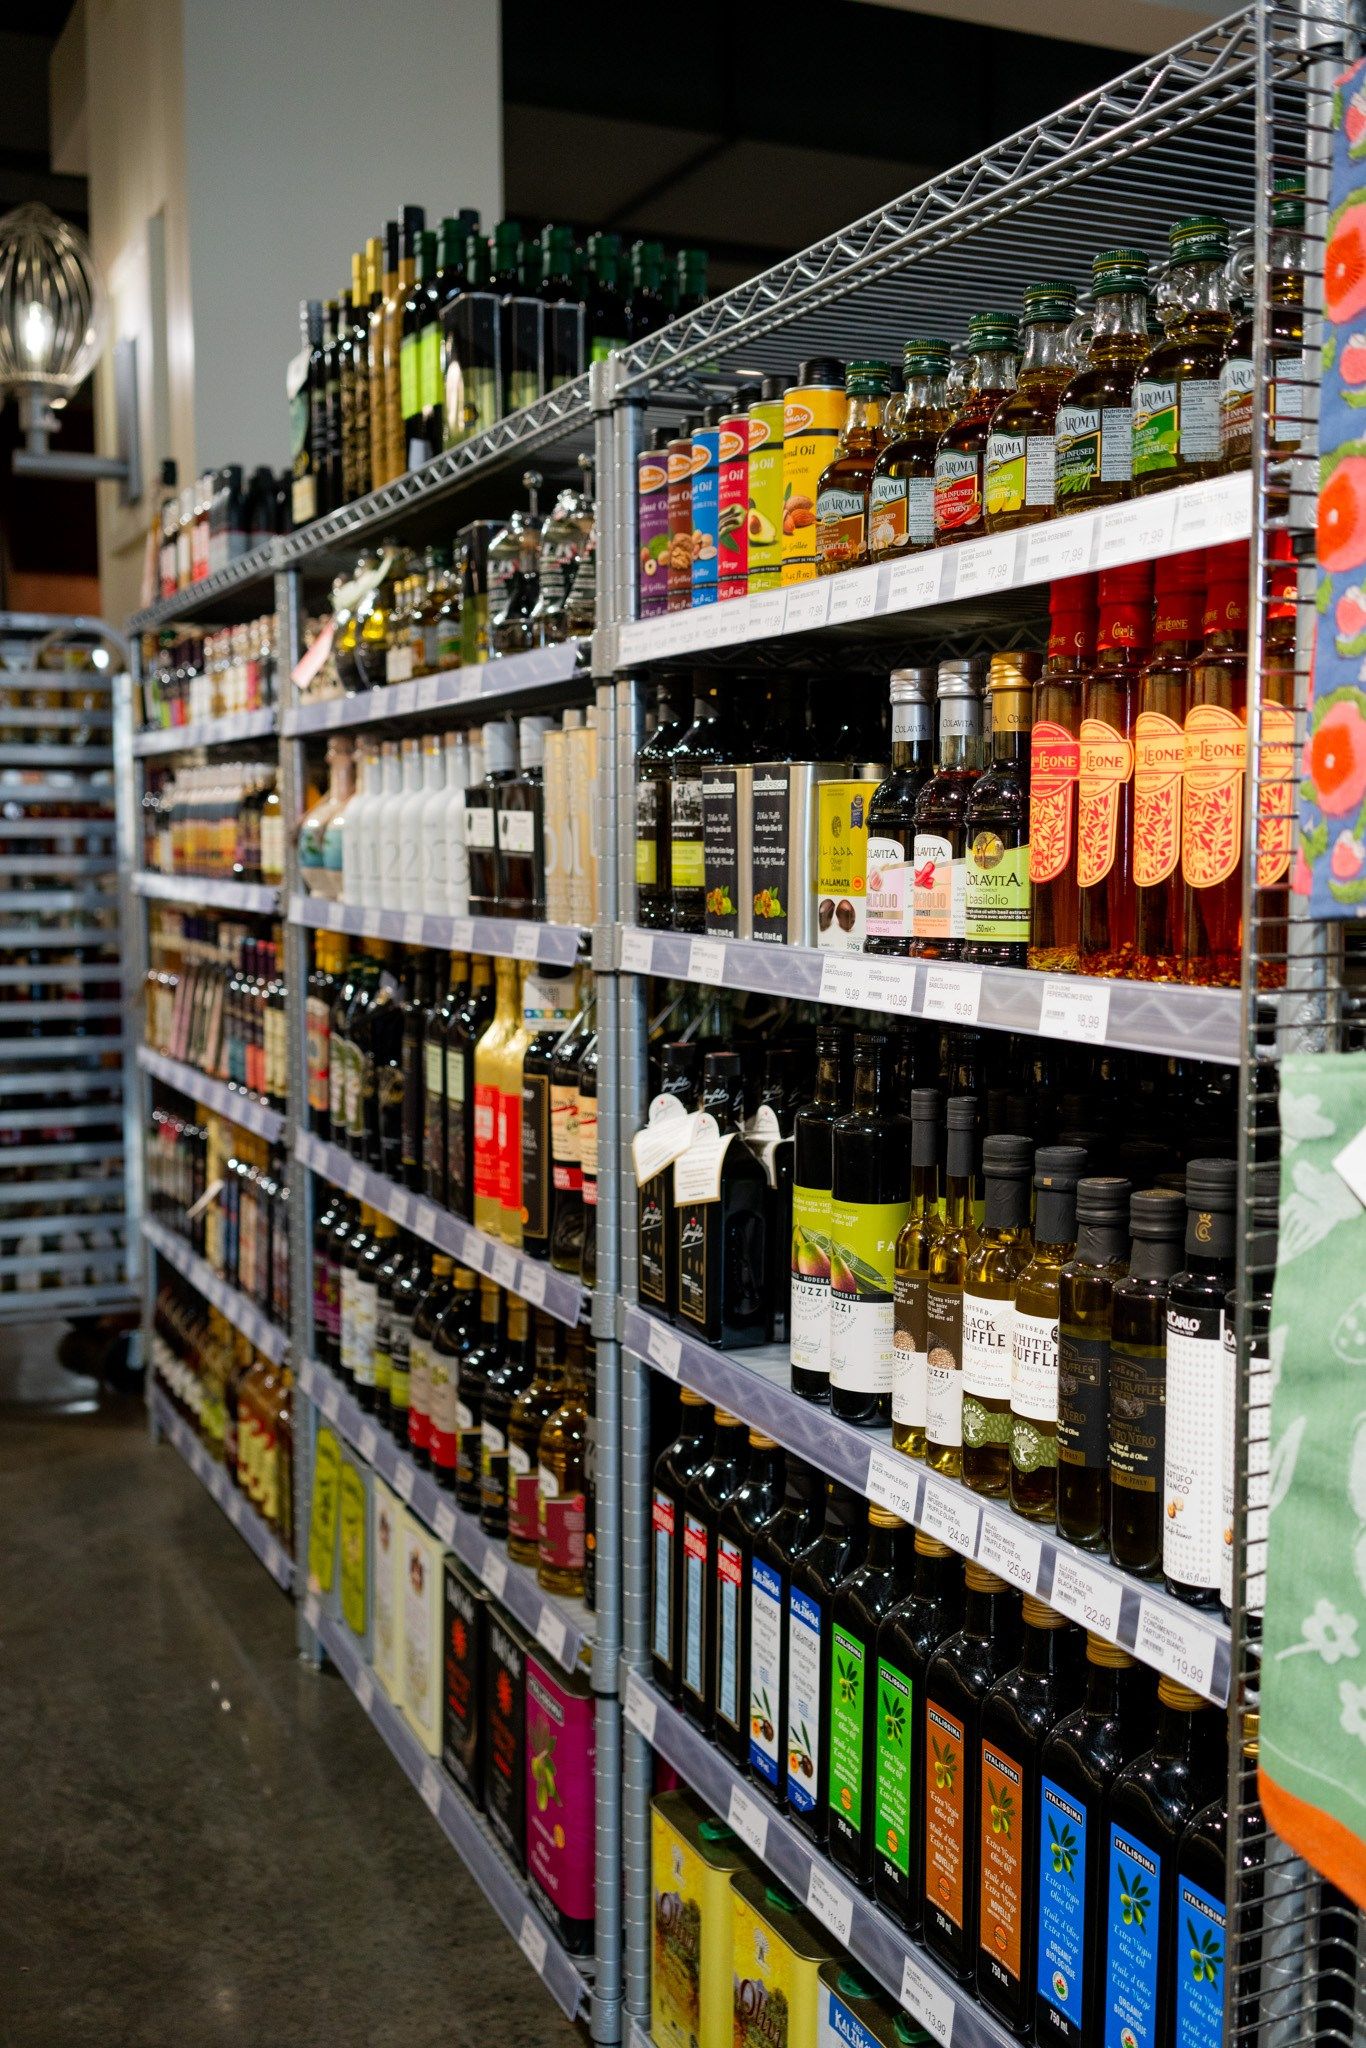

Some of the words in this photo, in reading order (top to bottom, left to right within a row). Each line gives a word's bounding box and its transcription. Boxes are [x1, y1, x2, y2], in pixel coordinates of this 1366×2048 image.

[1039, 751, 1078, 772] LEONE
[1086, 750, 1124, 772] LEONE
[1144, 745, 1184, 767] LEONE
[1200, 738, 1246, 762] LEONE
[926, 1503, 943, 1518] TRUFFLE
[927, 1495, 943, 1509] INFUSED
[942, 1504, 956, 1516] BLACK
[946, 1525, 970, 1548] $24.99
[984, 1527, 1002, 1542] INFUSED
[1002, 1536, 1016, 1549] WHITE
[984, 1534, 1002, 1551] TRUFFLE
[1001, 1544, 1013, 1555] OLIVE
[1013, 1553, 1022, 1562] OIL
[1007, 1560, 1032, 1584] $25.99
[1057, 1577, 1072, 1590] BLACK
[1058, 1570, 1078, 1585] TRUFFLE
[1083, 1604, 1111, 1631] $22.99
[1143, 1616, 1177, 1640] CONDIMENTO
[1178, 1636, 1185, 1645] AL
[1142, 1625, 1166, 1644] TARTUFO
[1166, 1639, 1187, 1655] BIANCO
[1172, 1655, 1204, 1683] $19.99
[930, 1709, 961, 1740] ITALISSIMA
[985, 1751, 1019, 1784] ITALISSIMA
[1045, 1790, 1082, 1824] ITALISSIMA
[1114, 1837, 1155, 1874] ITALISSIMA
[1044, 1871, 1062, 1891] Extra
[1062, 1883, 1080, 1906] Virgin
[1065, 1901, 1075, 1915] Oil
[1043, 1919, 1061, 1938] Extra
[1113, 1923, 1132, 1944] Extra
[1132, 1936, 1152, 1960] Virgin
[1045, 1948, 1076, 1981] BIOLOGIQUE
[1050, 1940, 1073, 1966] ORGANIC
[1119, 1942, 1135, 1960] Olive
[1135, 1955, 1146, 1969] Oil
[991, 1962, 1001, 1979] 750
[1112, 1973, 1130, 1993] Extra
[1131, 1988, 1151, 2011] Vierge
[1183, 1979, 1203, 2000] Extra
[1113, 2003, 1148, 2038] BIOLOGIQUE
[1118, 1995, 1143, 2022] ORGANIC
[1189, 2000, 1206, 2018] Olive
[1207, 2014, 1218, 2028] Oil
[1050, 2009, 1060, 2027] 750
[1060, 2018, 1069, 2036] mL
